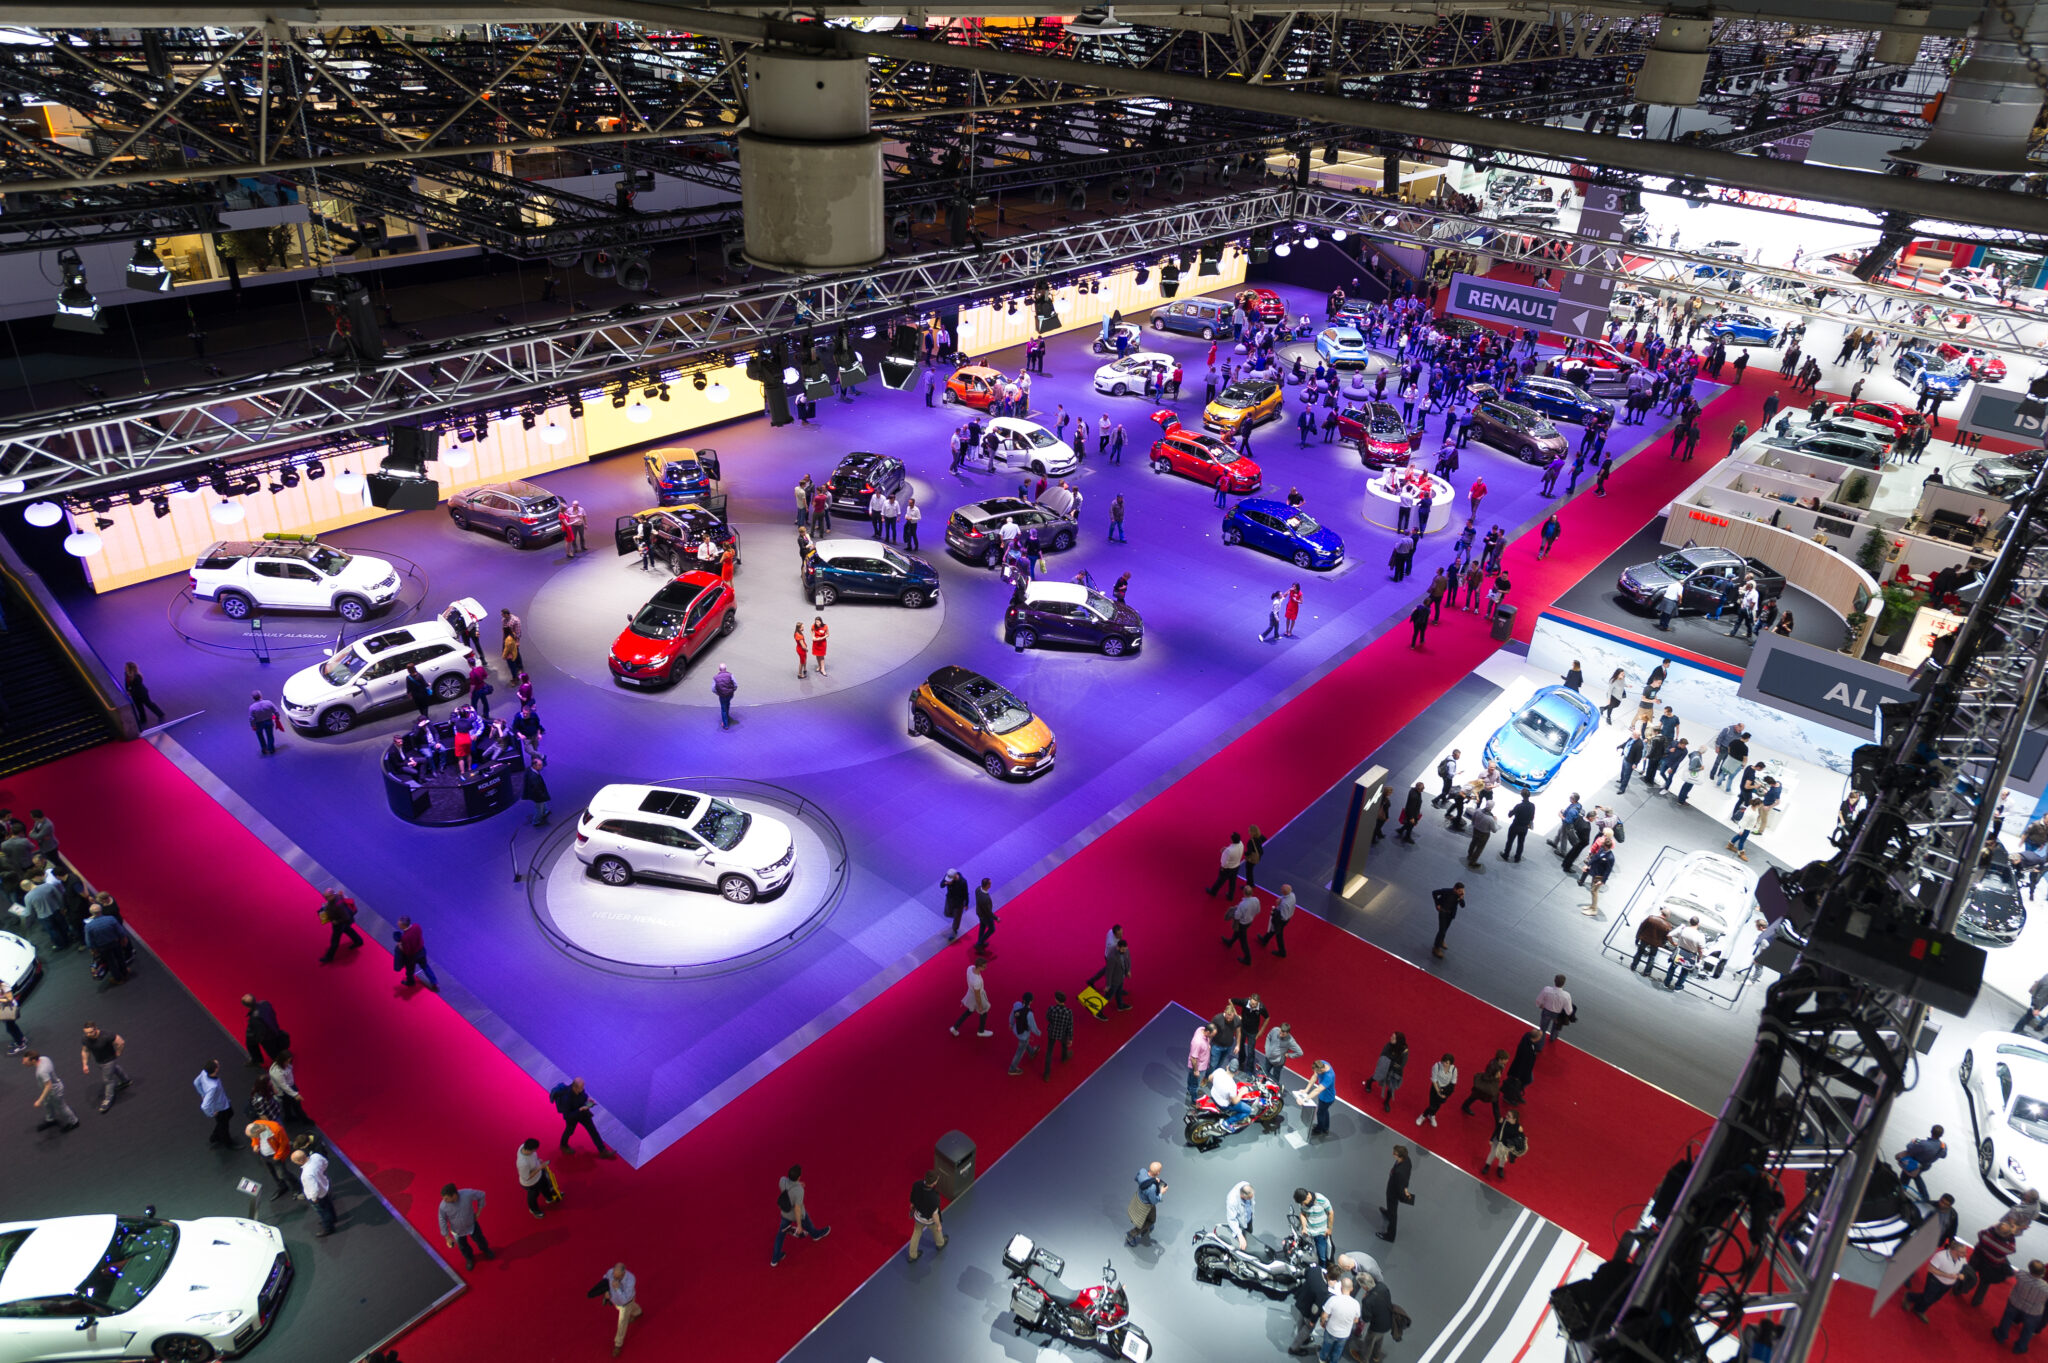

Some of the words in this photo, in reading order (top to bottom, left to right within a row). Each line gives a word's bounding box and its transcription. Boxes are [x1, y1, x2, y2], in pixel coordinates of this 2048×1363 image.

[1604, 193, 1618, 210] 3
[1468, 289, 1557, 320] RENAULT
[1688, 510, 1729, 527] ISUZU
